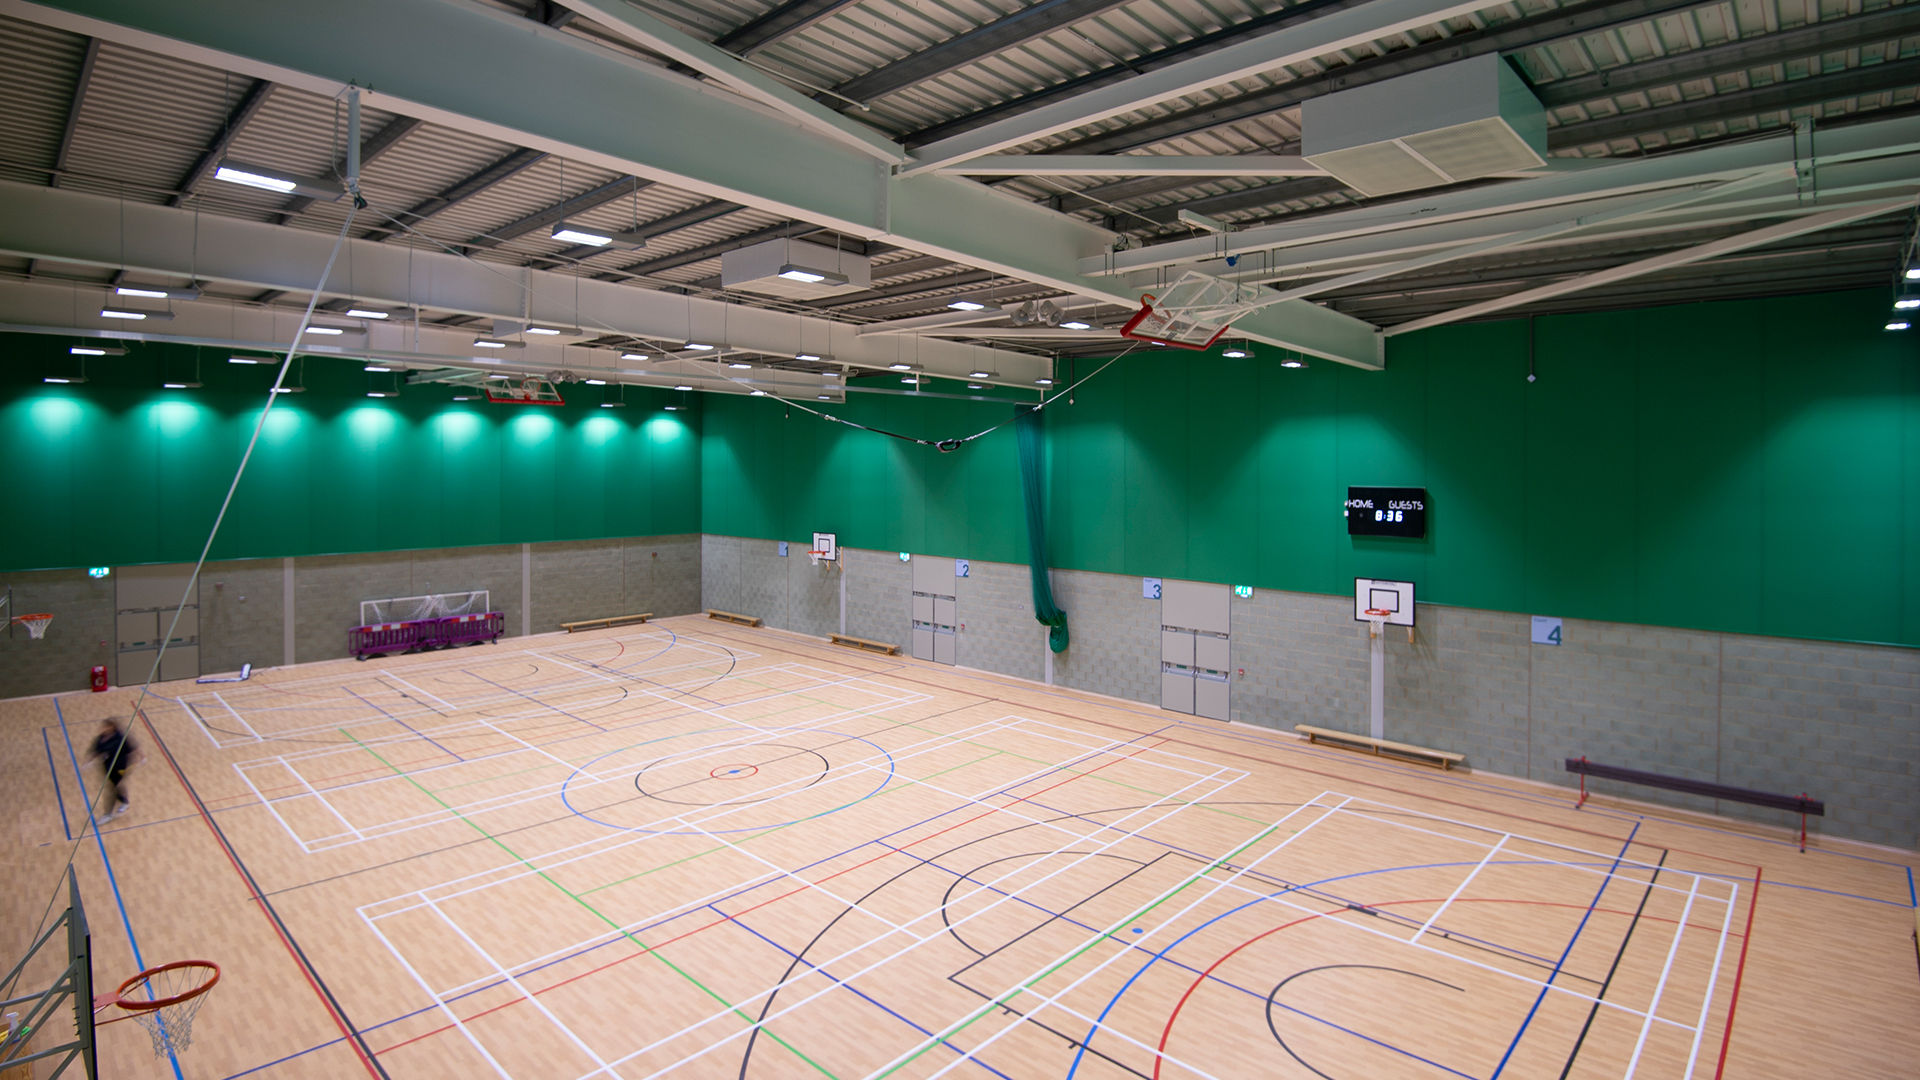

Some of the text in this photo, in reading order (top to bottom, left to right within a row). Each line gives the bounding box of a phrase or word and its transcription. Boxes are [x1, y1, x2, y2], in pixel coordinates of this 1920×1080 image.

[1348, 499, 1424, 510] HOME GUESTS
[1375, 510, 1403, 522] 8:36
[963, 564, 969, 577] 2
[1153, 584, 1162, 599] 3
[1547, 625, 1562, 646] 4
